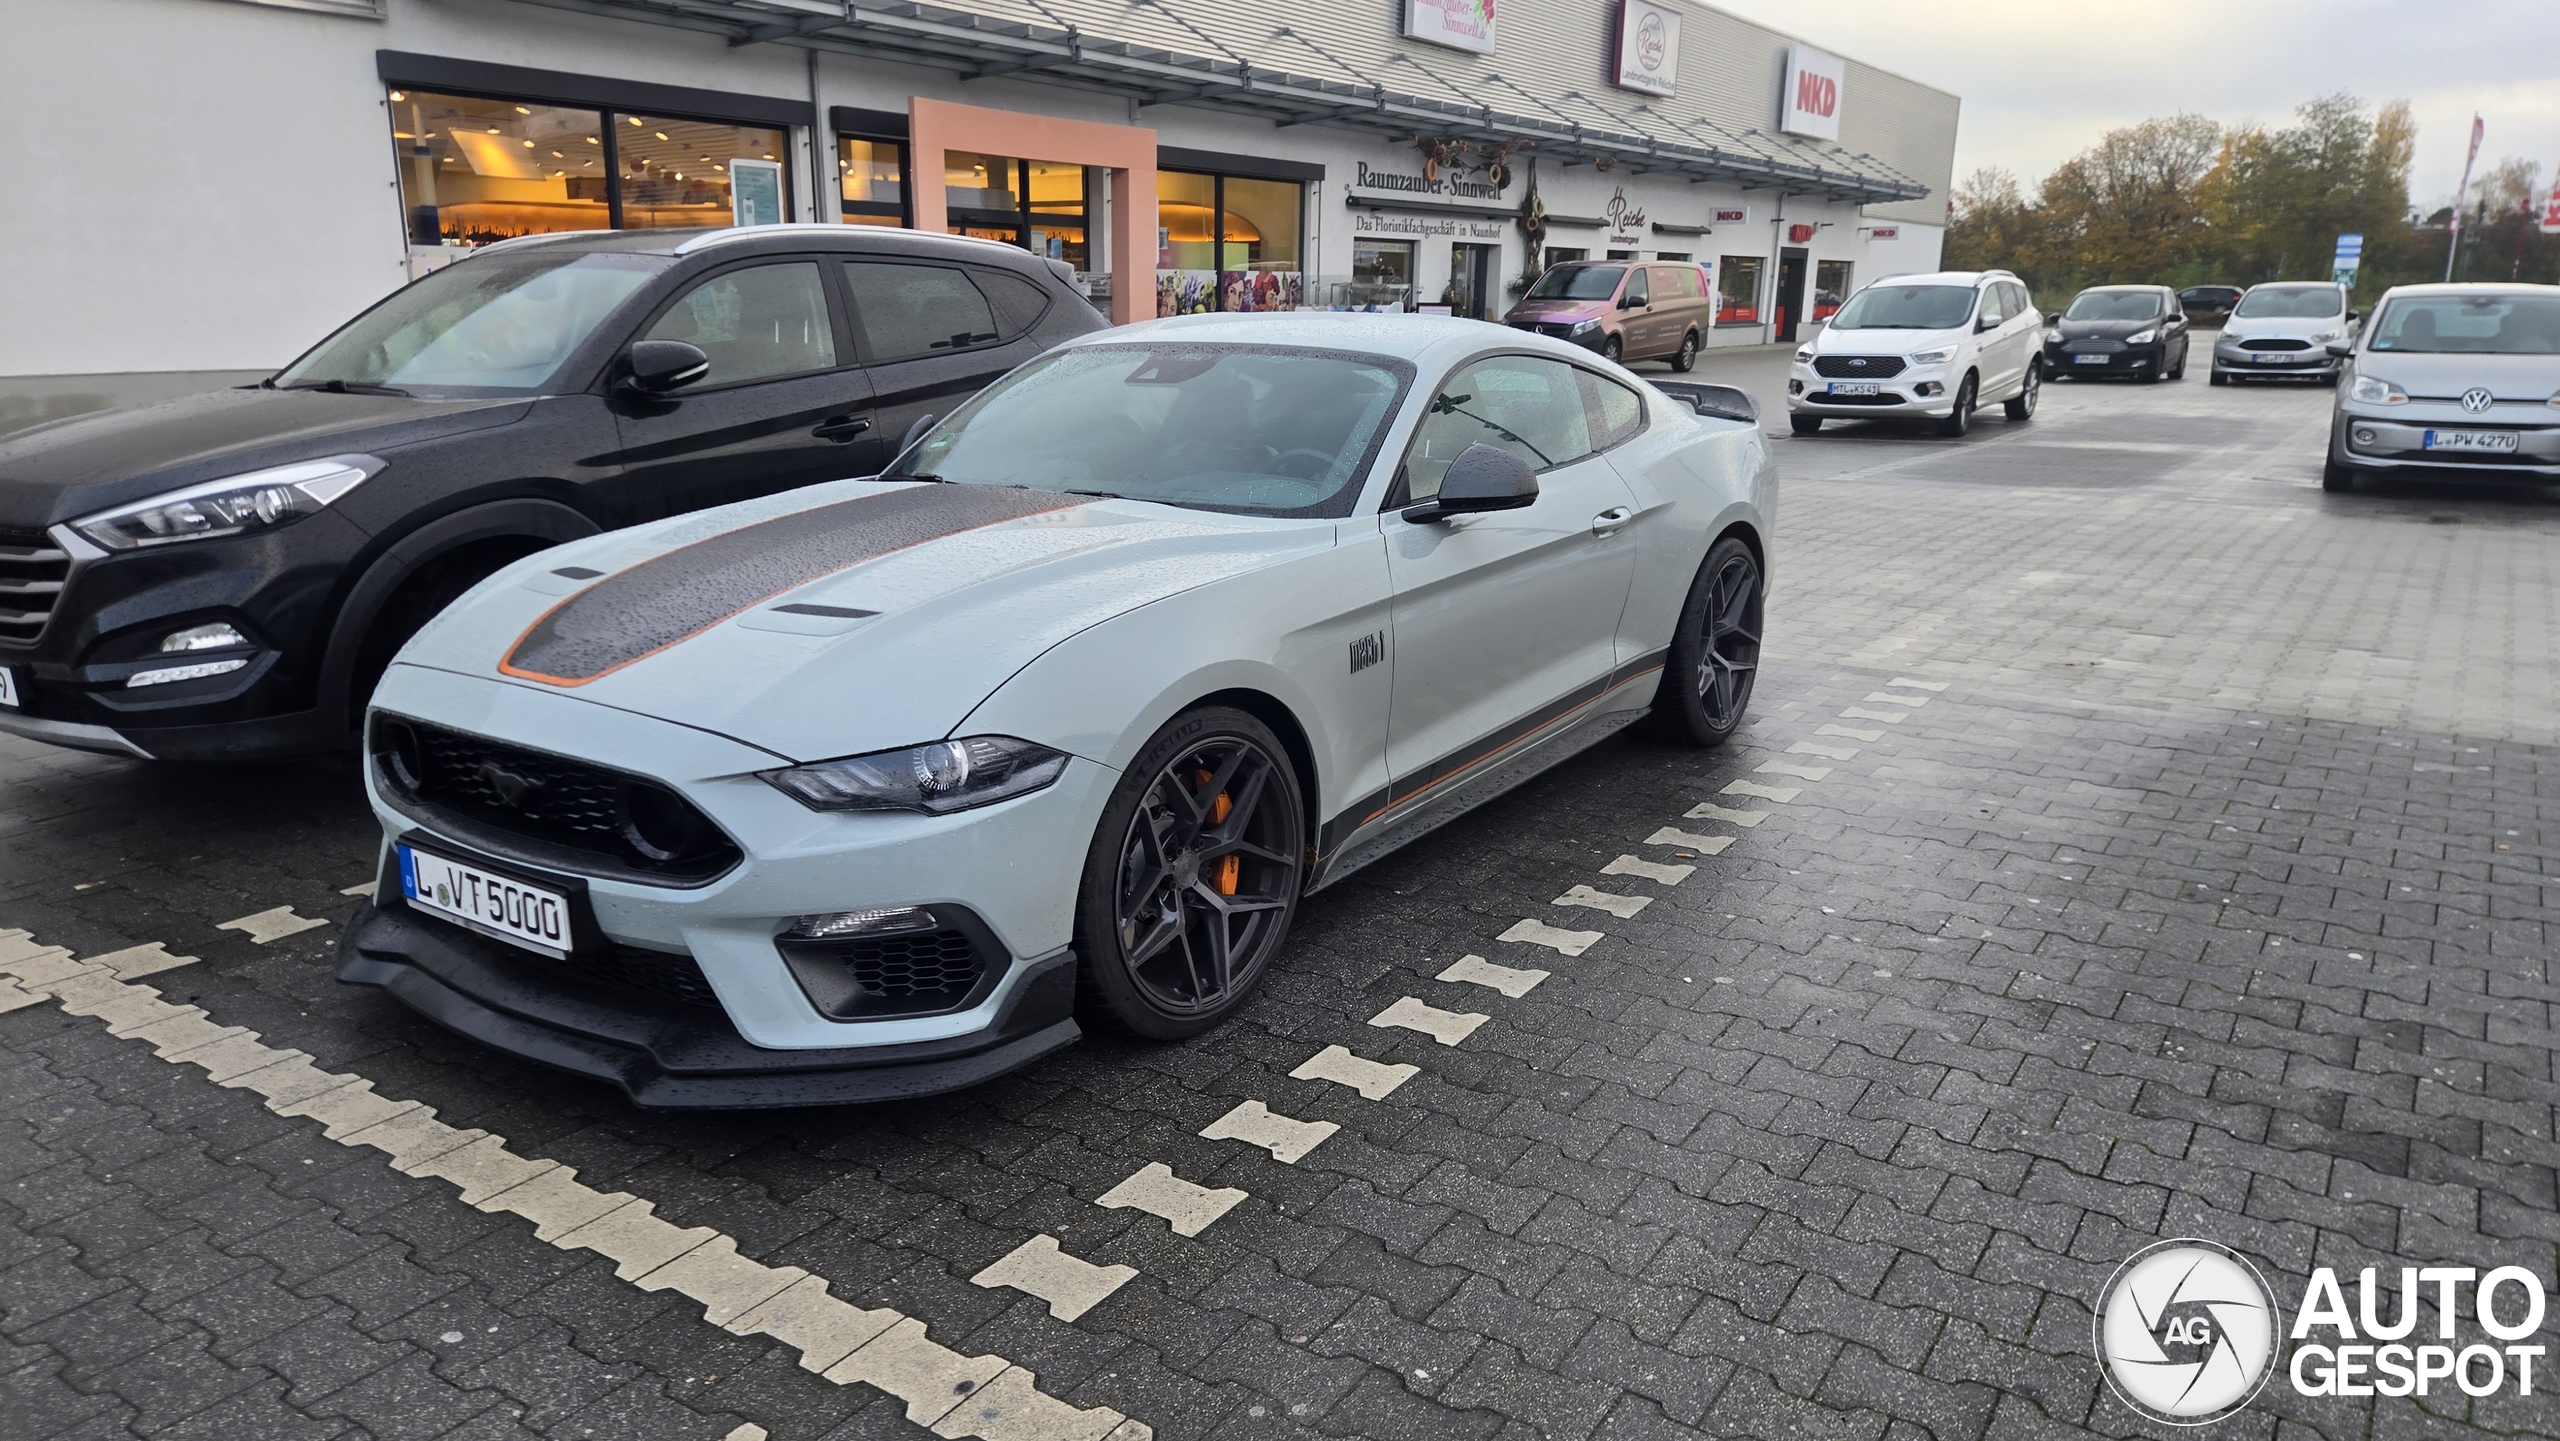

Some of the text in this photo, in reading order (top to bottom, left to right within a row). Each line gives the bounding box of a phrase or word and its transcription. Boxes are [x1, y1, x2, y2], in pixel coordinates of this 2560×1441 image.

[1797, 69, 1836, 118] NKD
[1717, 211, 1743, 221] NKD
[1356, 214, 1502, 239] Das Floristikfachgeschäft in Naunhof
[1873, 229, 1895, 238] NKD
